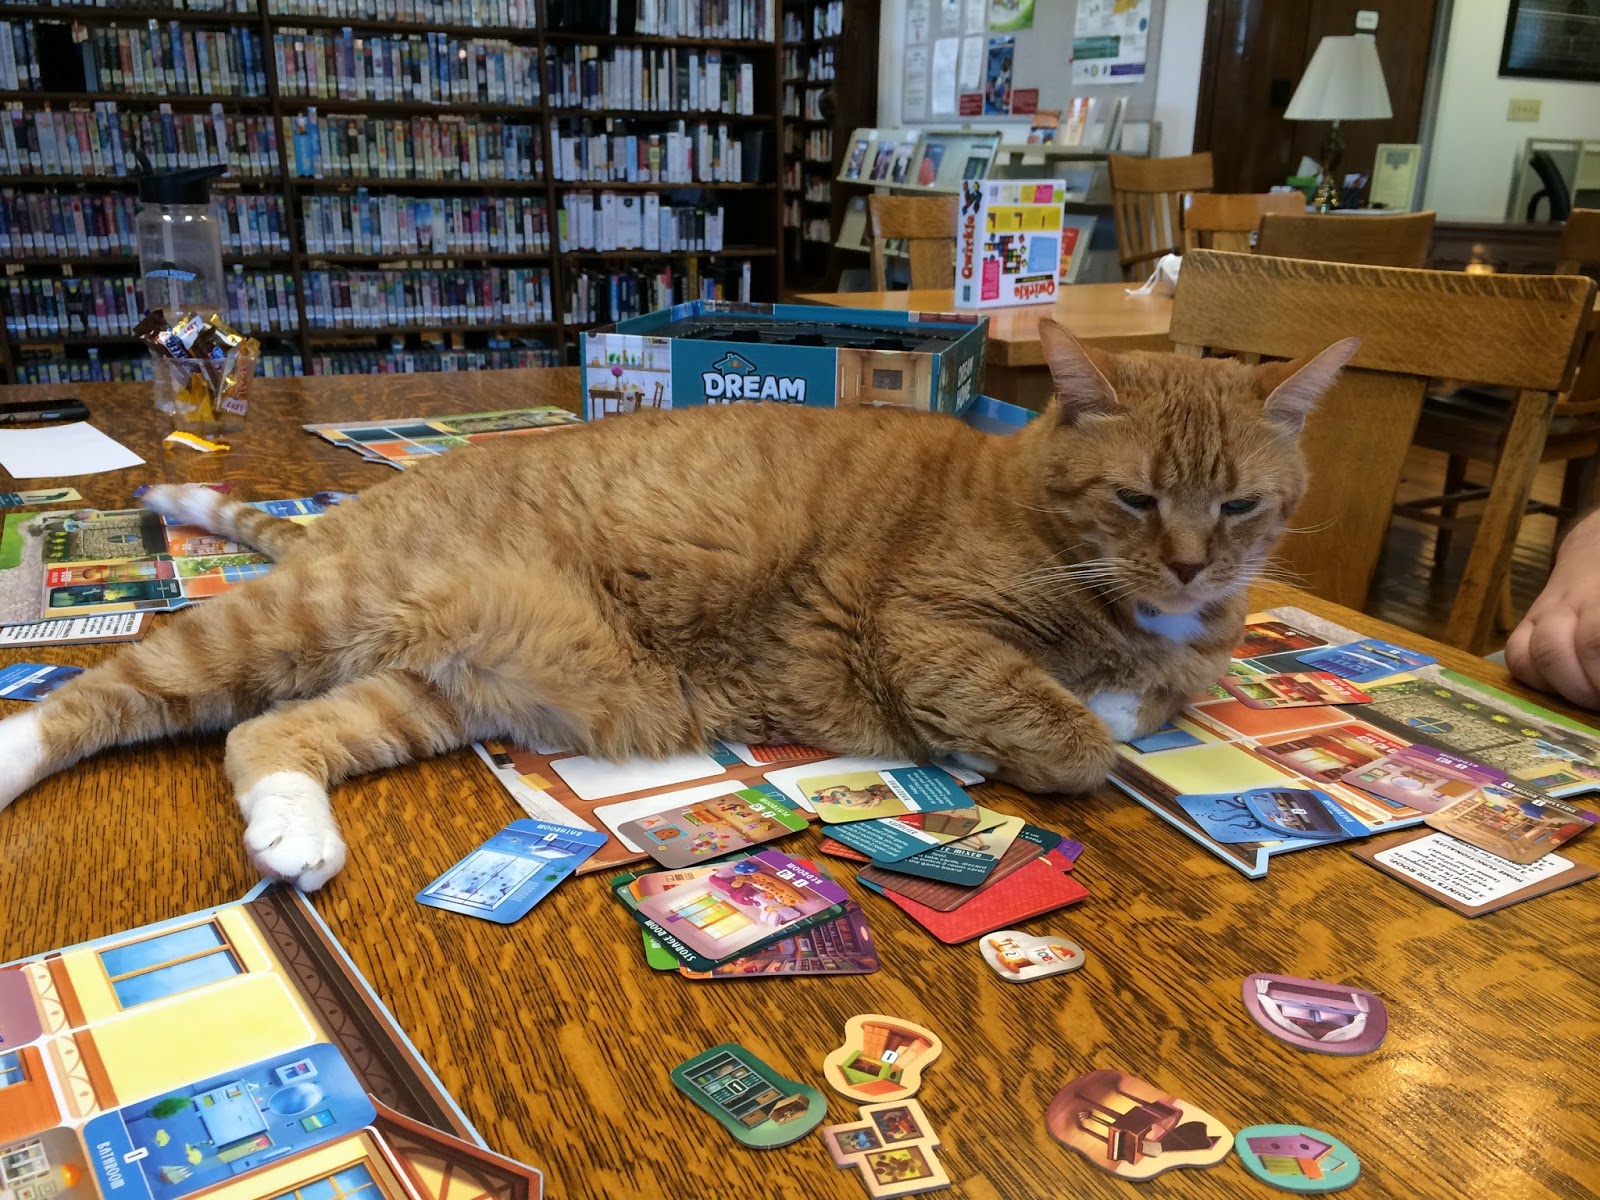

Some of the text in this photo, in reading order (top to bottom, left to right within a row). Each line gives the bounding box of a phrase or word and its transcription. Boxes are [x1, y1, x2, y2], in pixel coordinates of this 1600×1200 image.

[962, 215, 975, 279] Qwirkle
[1014, 280, 1055, 300] Qwirkle
[701, 372, 806, 402] DREAM
[537, 824, 583, 837] BATHROOM
[954, 848, 982, 858] MIXER
[786, 862, 823, 885] BEDROOM
[1417, 872, 1436, 883] FOR
[1496, 870, 1524, 883] HOME
[1437, 882, 1472, 901] POINTS
[644, 920, 667, 936] ROOM
[663, 935, 697, 962] STORAGE
[96, 1141, 125, 1190] BATHROOM
